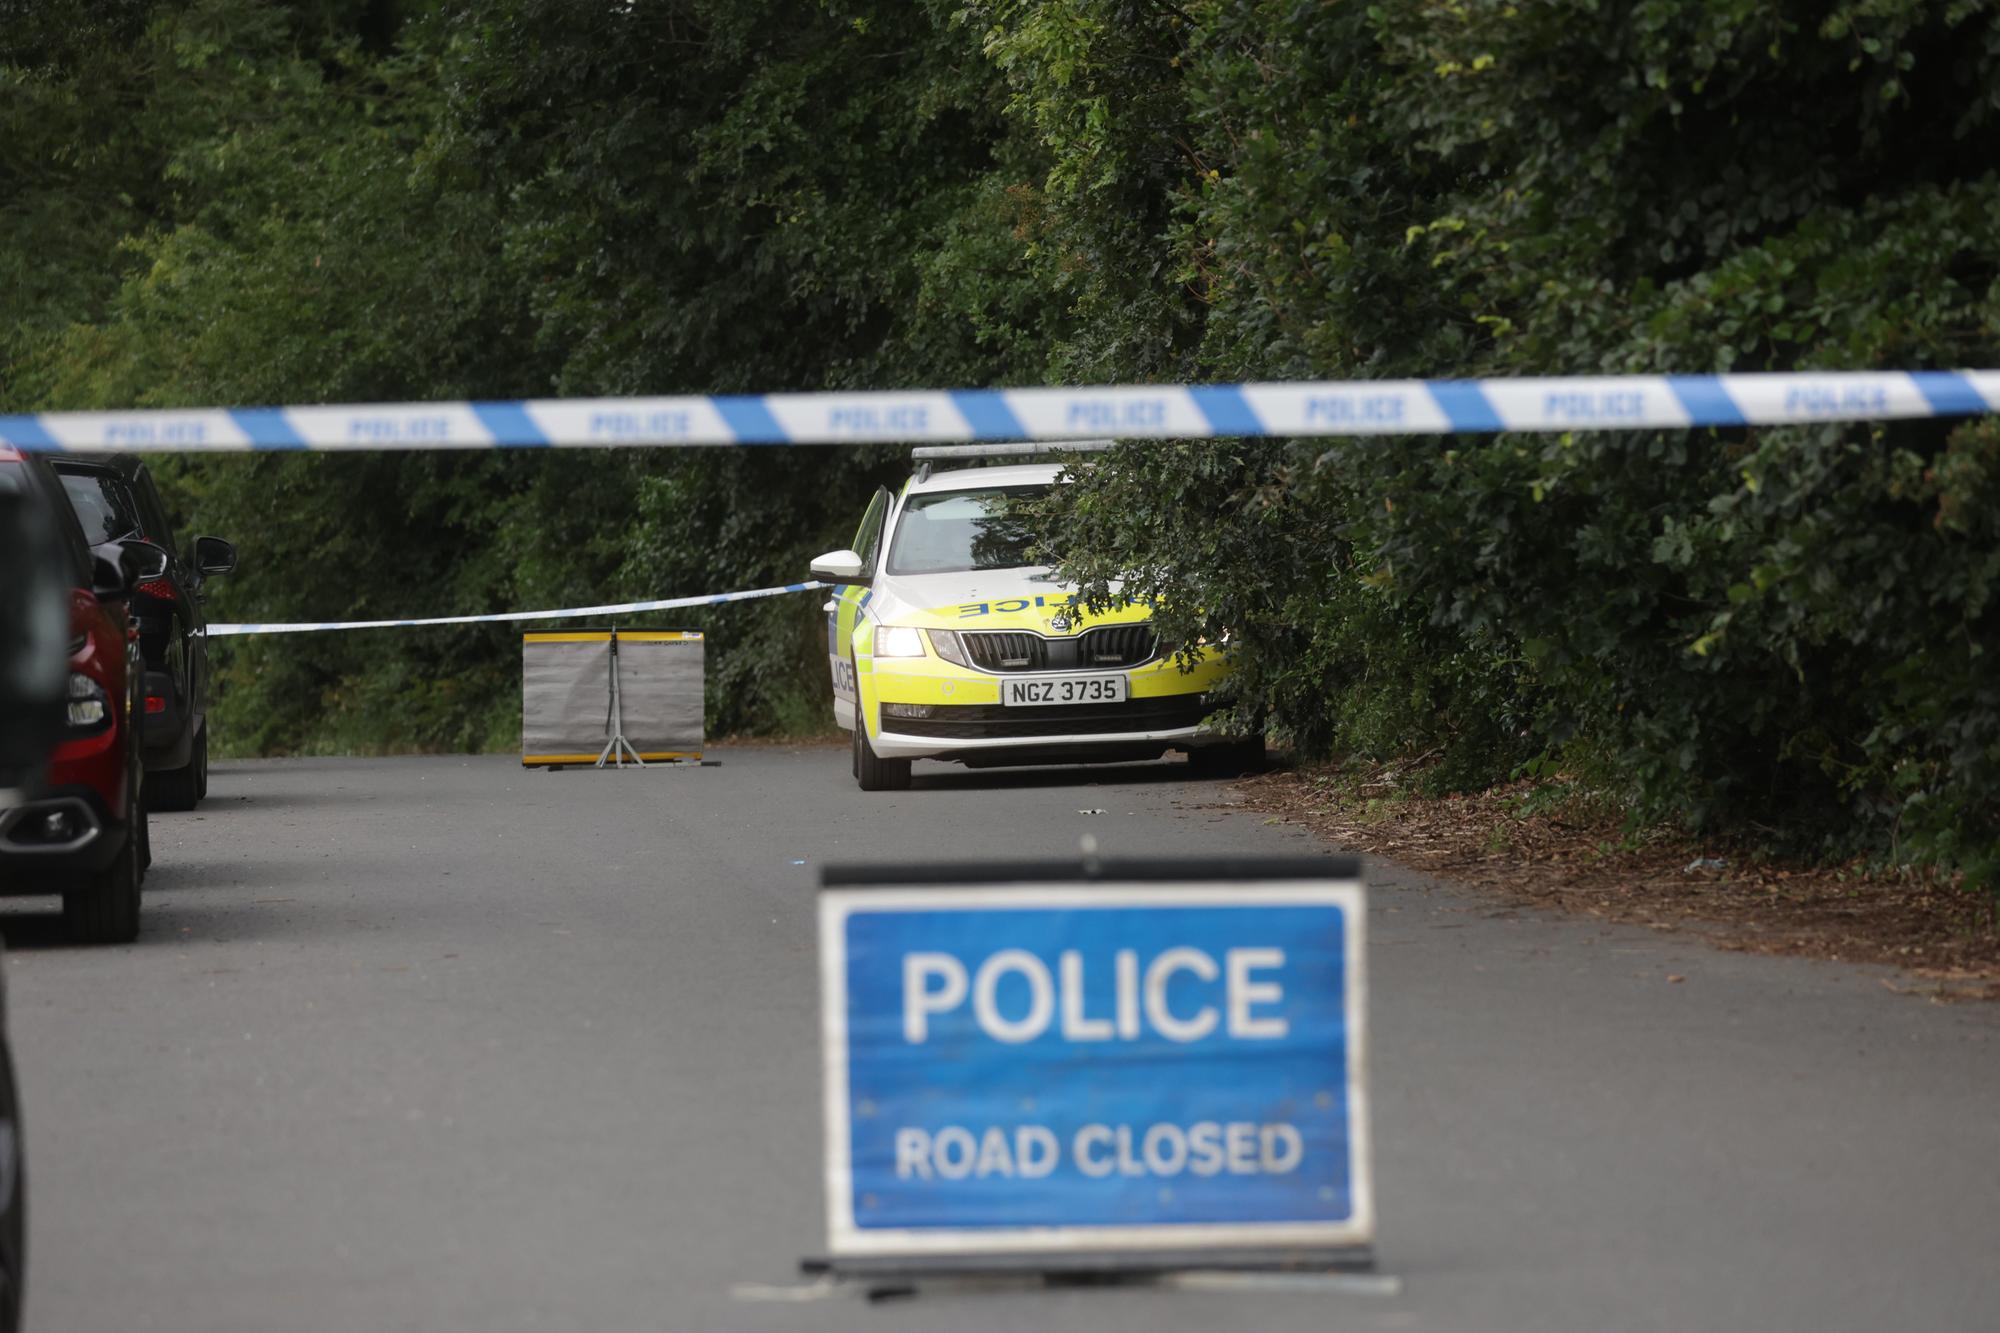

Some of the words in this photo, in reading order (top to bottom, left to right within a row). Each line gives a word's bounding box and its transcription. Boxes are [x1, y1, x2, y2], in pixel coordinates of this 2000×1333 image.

[589, 411, 691, 437] POLICE
[828, 406, 930, 432] POLICE
[1066, 400, 1168, 427] POLICE
[1305, 396, 1406, 423] POLICE
[1543, 391, 1645, 418] POLICE
[1013, 682, 1054, 702] NGZ
[1061, 680, 1116, 700] 3735
[903, 946, 1289, 1043] POLICE
[896, 1126, 1059, 1179] ROAD
[1073, 1122, 1302, 1176] CLOSED
